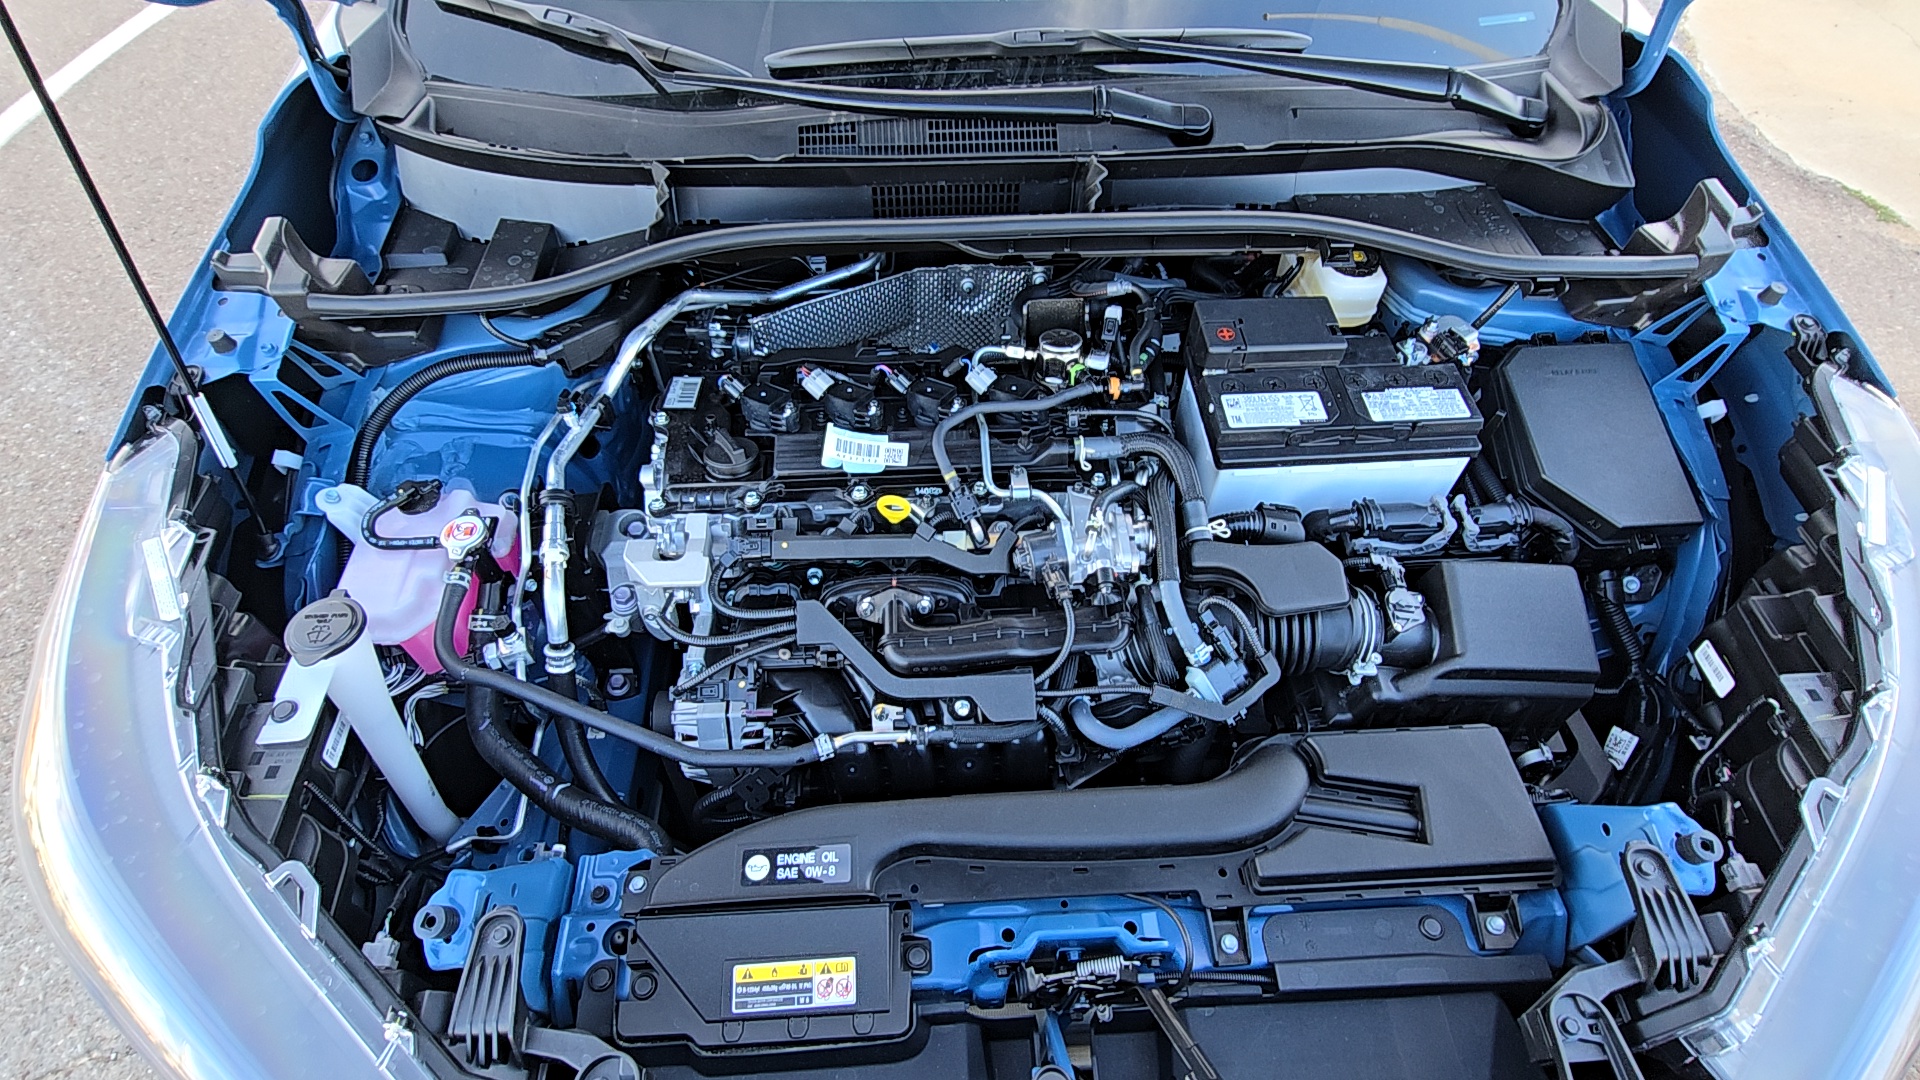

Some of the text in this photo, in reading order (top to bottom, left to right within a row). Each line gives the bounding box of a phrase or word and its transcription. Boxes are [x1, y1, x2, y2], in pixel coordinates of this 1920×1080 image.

[776, 851, 840, 866] ENGINE OIL
[776, 865, 836, 880] SAE 0W-8
